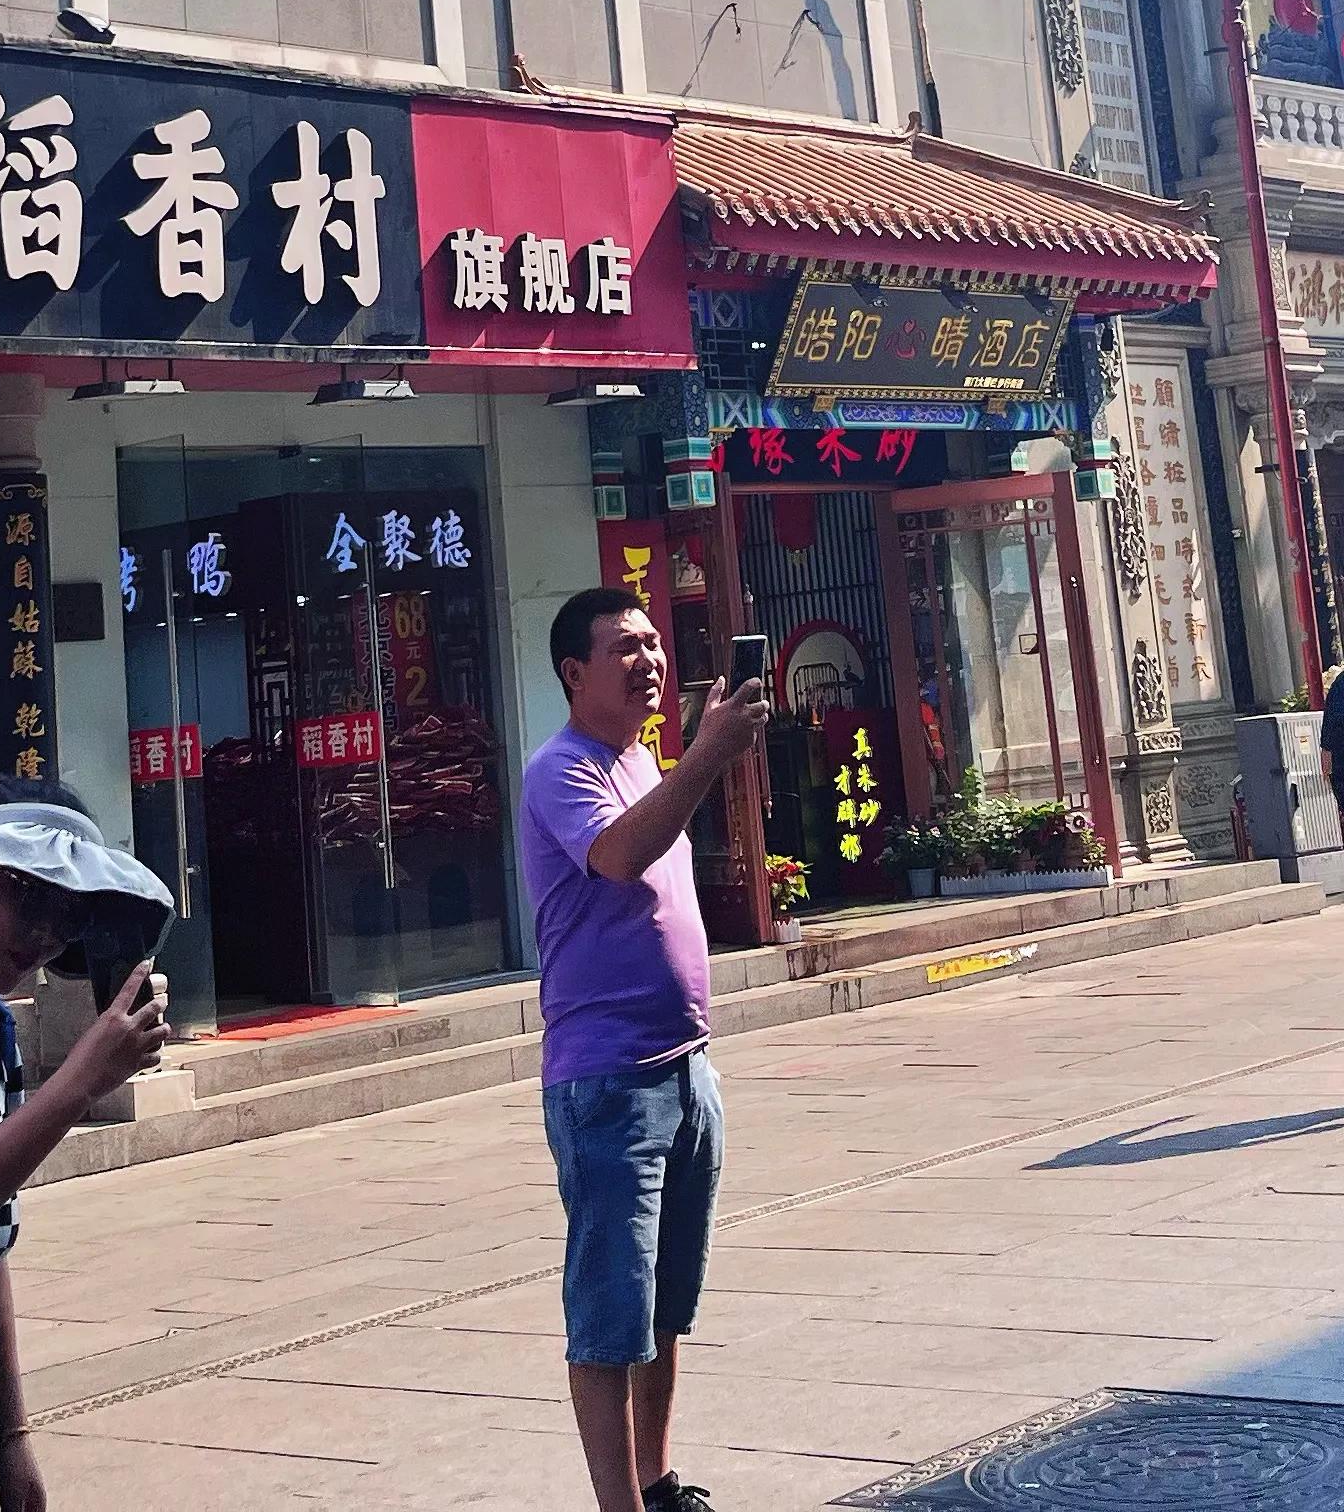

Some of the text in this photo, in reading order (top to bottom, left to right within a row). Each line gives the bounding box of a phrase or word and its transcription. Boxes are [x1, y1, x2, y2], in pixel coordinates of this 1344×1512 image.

[449, 228, 632, 316] 旗舰店
[326, 509, 472, 573] 全聚德
[302, 718, 375, 762] 稻香村
